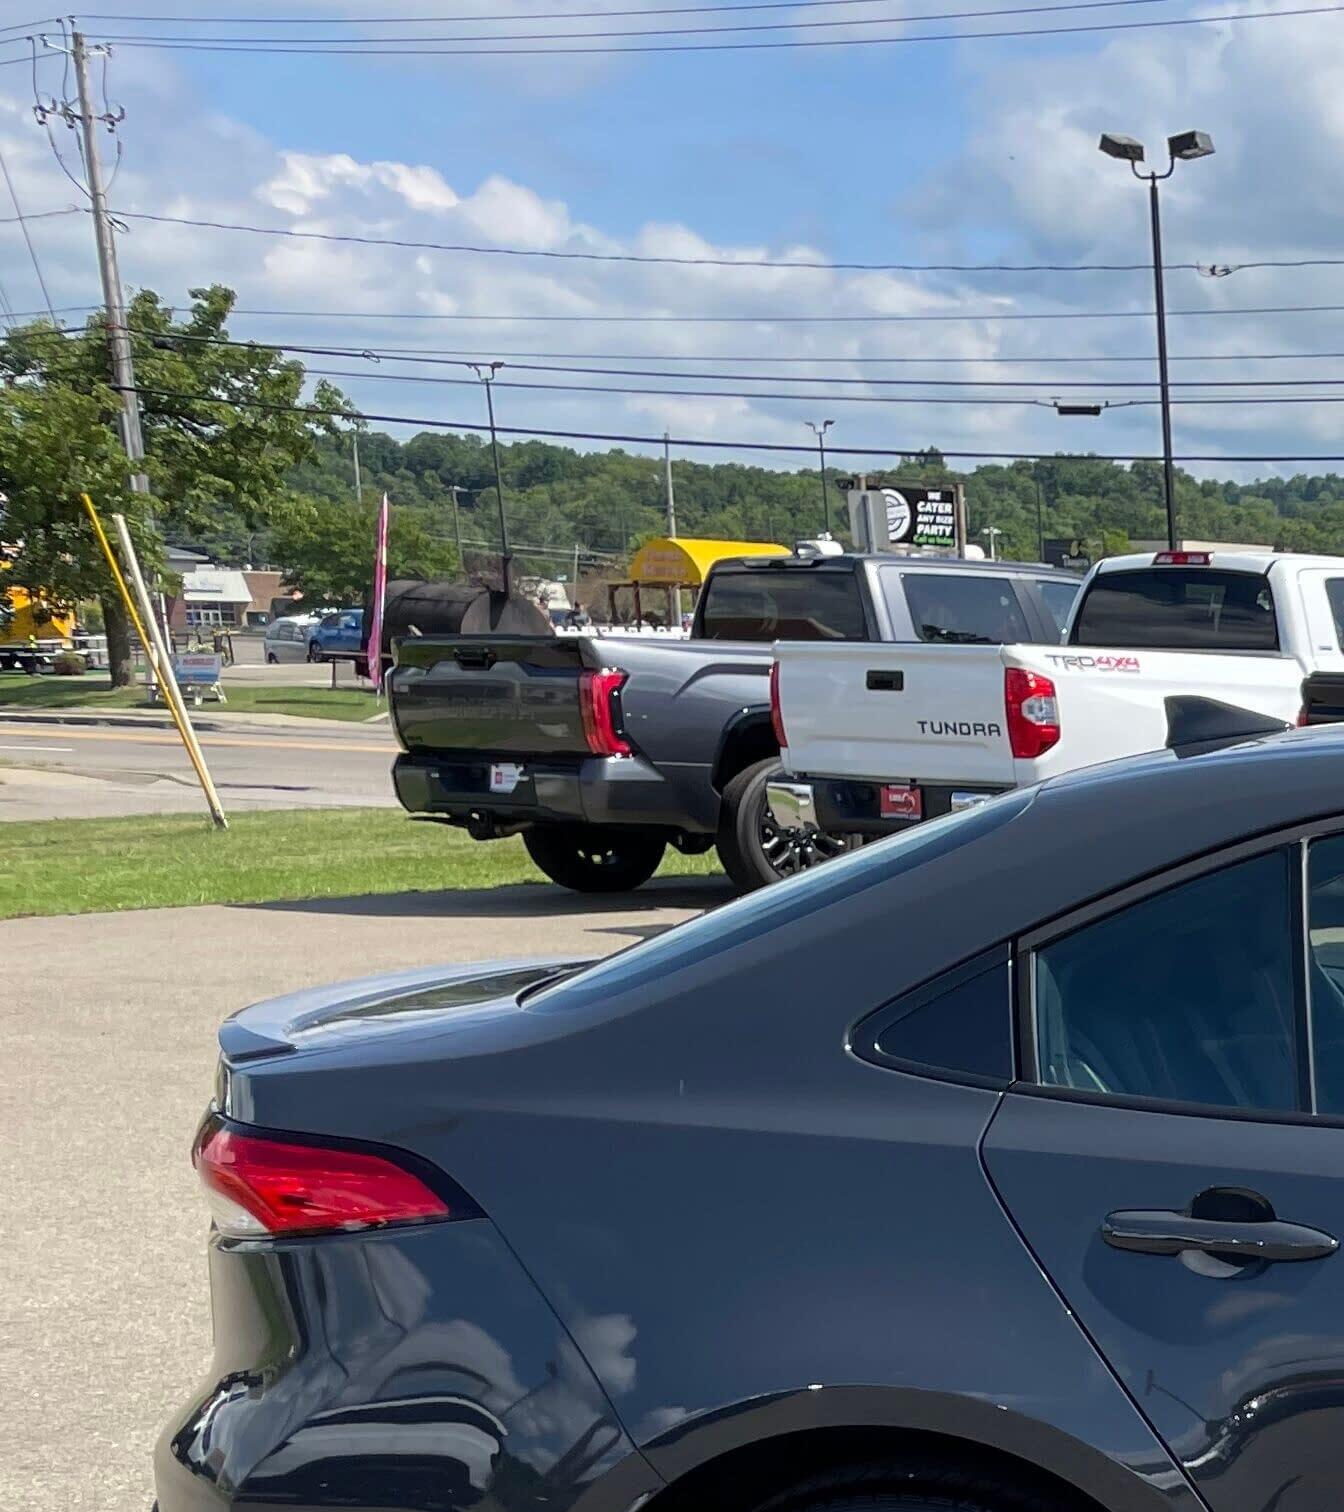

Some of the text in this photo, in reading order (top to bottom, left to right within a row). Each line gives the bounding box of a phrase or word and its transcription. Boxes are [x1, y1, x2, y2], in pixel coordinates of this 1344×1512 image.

[917, 501, 953, 514] CATER
[917, 524, 953, 537] PARTY
[1045, 654, 1096, 671] TRD
[916, 720, 1002, 737] TUNDRA
